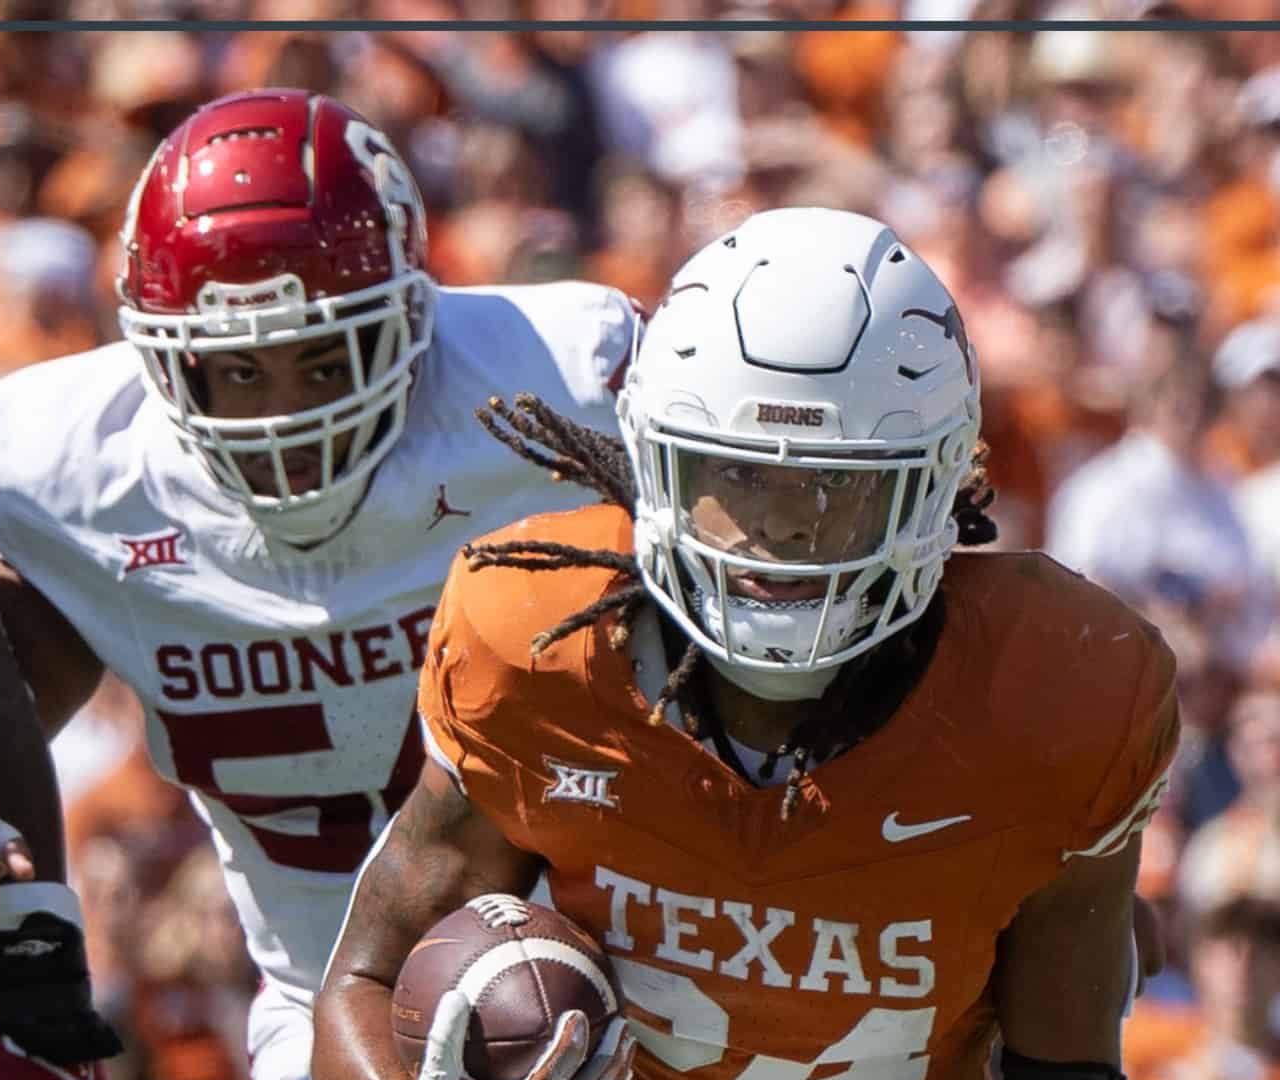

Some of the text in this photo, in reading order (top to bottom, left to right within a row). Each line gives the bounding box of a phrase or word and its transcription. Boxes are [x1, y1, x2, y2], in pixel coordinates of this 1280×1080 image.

[756, 403, 824, 427] HORNS
[120, 531, 187, 574] XII
[544, 758, 619, 808] XII
[595, 864, 936, 998] TEXAS
